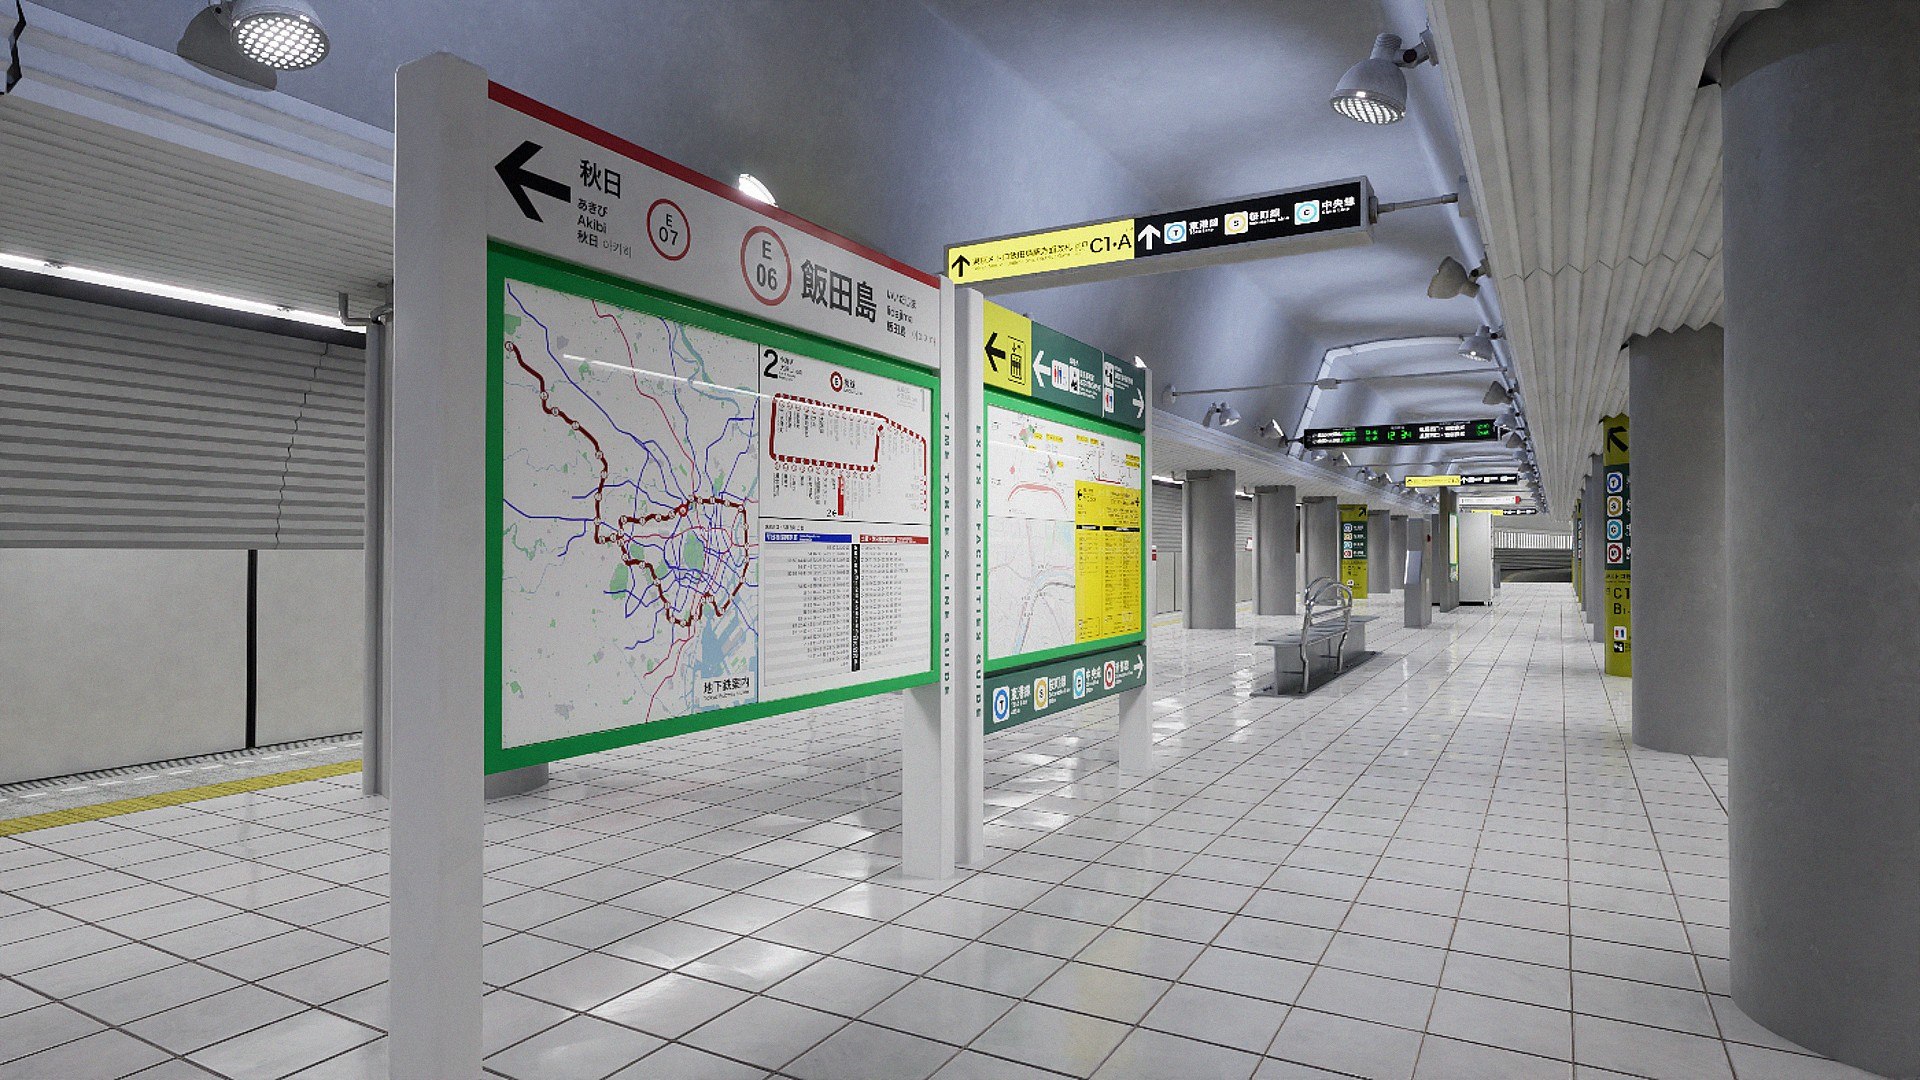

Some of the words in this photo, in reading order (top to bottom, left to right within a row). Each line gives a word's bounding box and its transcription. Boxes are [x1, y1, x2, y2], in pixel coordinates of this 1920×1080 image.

[580, 159, 621, 199] 秋日
[578, 199, 608, 217] あきび
[577, 214, 607, 233] Akibi
[666, 213, 673, 228] E
[659, 226, 678, 246] 07
[762, 239, 772, 260] E
[756, 263, 778, 291] 06
[800, 259, 877, 323] 飯田島
[763, 349, 779, 379] 2
